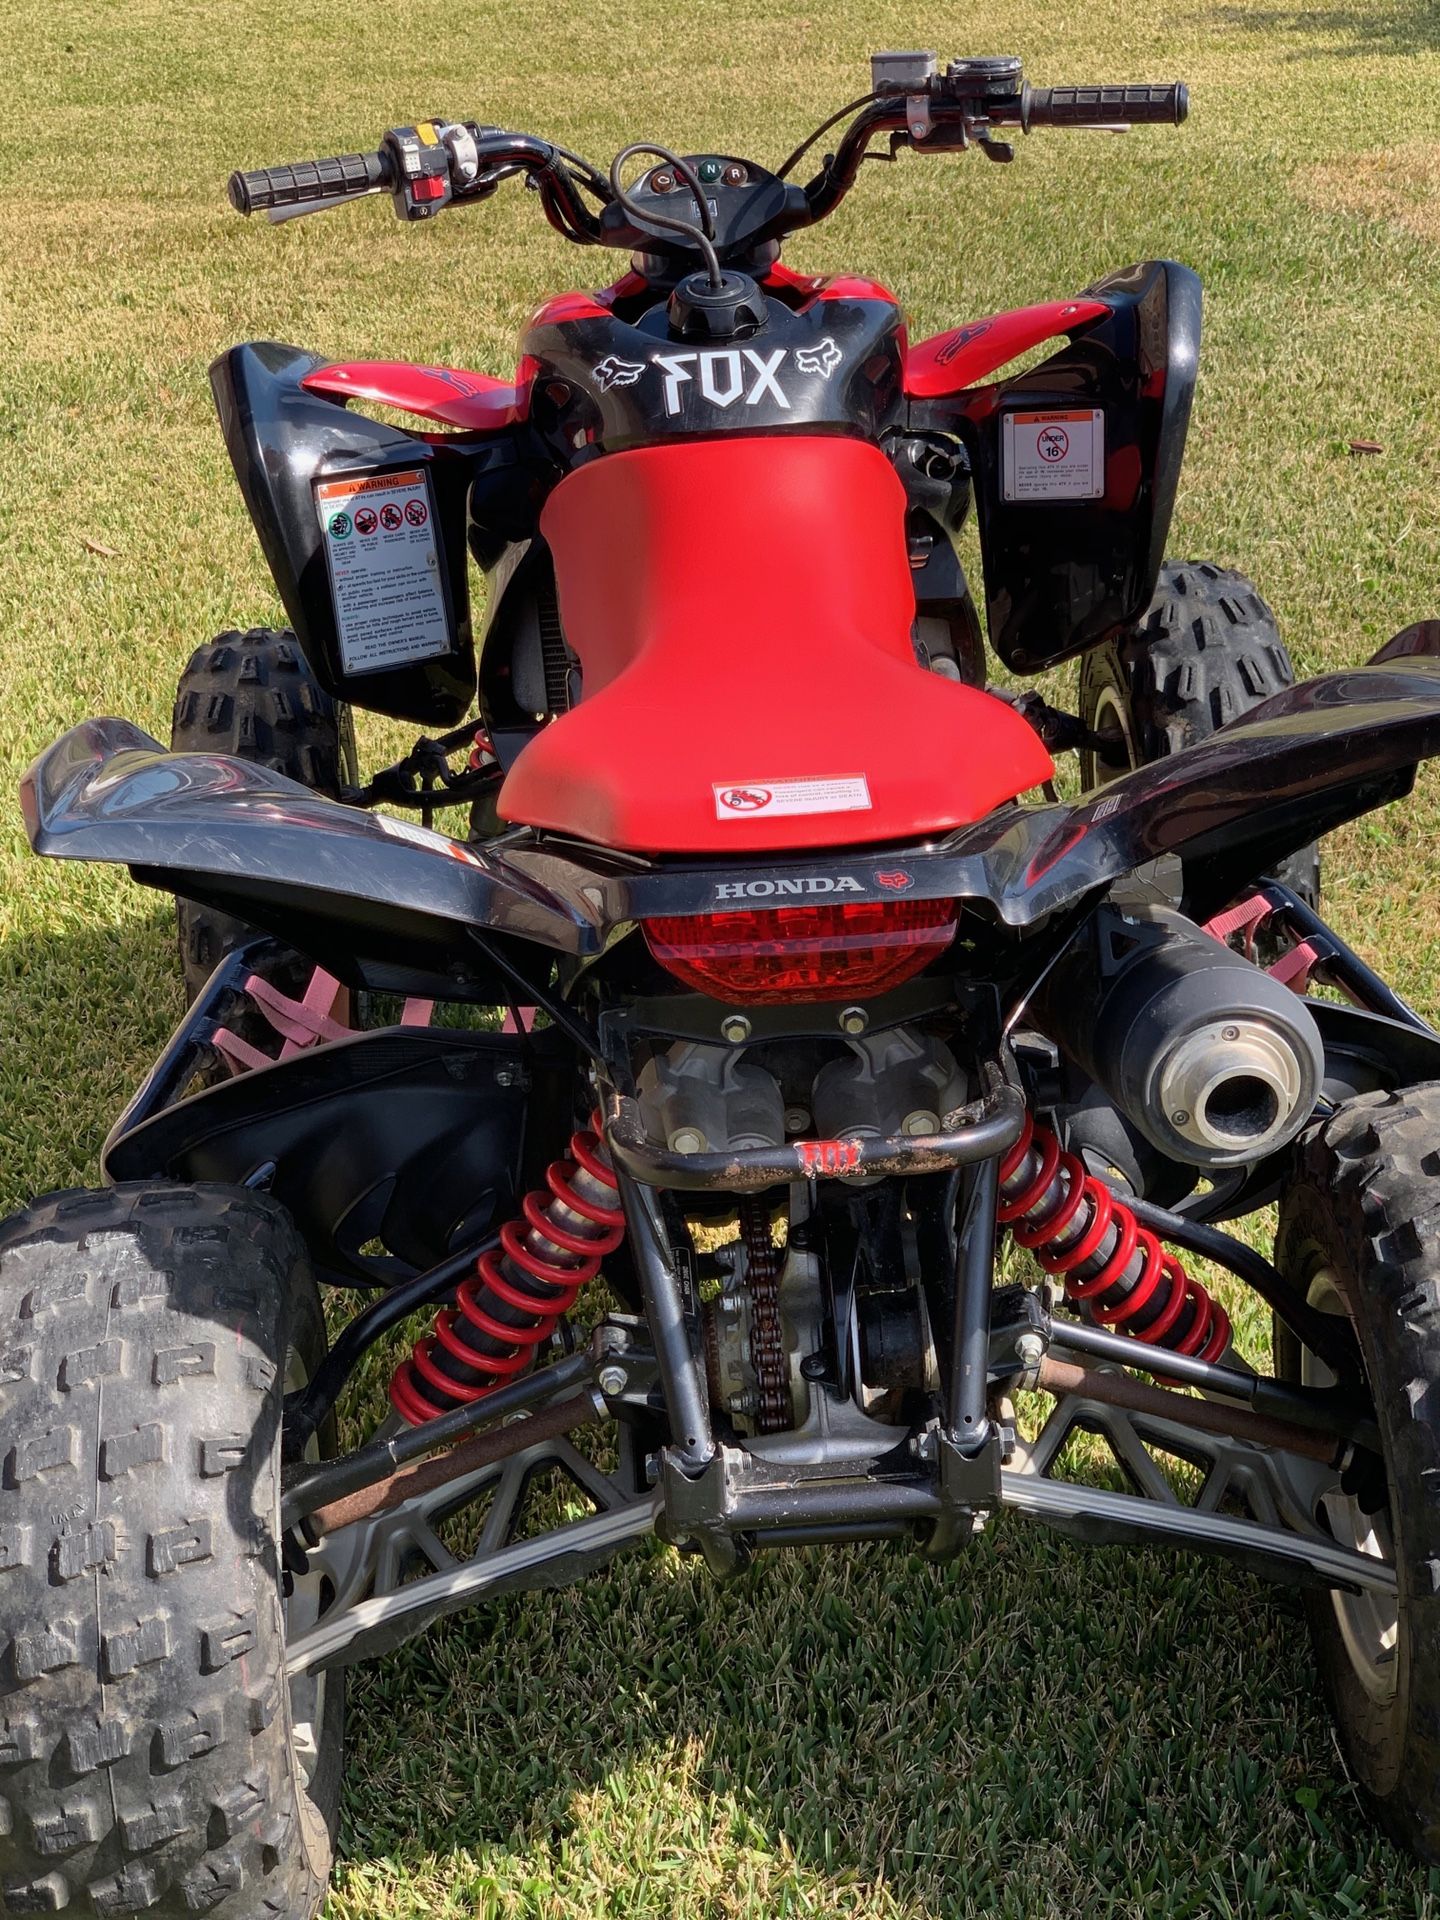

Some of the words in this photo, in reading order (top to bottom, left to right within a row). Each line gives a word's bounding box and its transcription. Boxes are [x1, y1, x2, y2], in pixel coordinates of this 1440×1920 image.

[707, 164, 716, 174] N
[731, 168, 740, 178] R
[652, 350, 791, 416] FOX
[1045, 446, 1059, 457] 16
[358, 478, 399, 491] WARNING
[715, 876, 866, 900] HONDA
